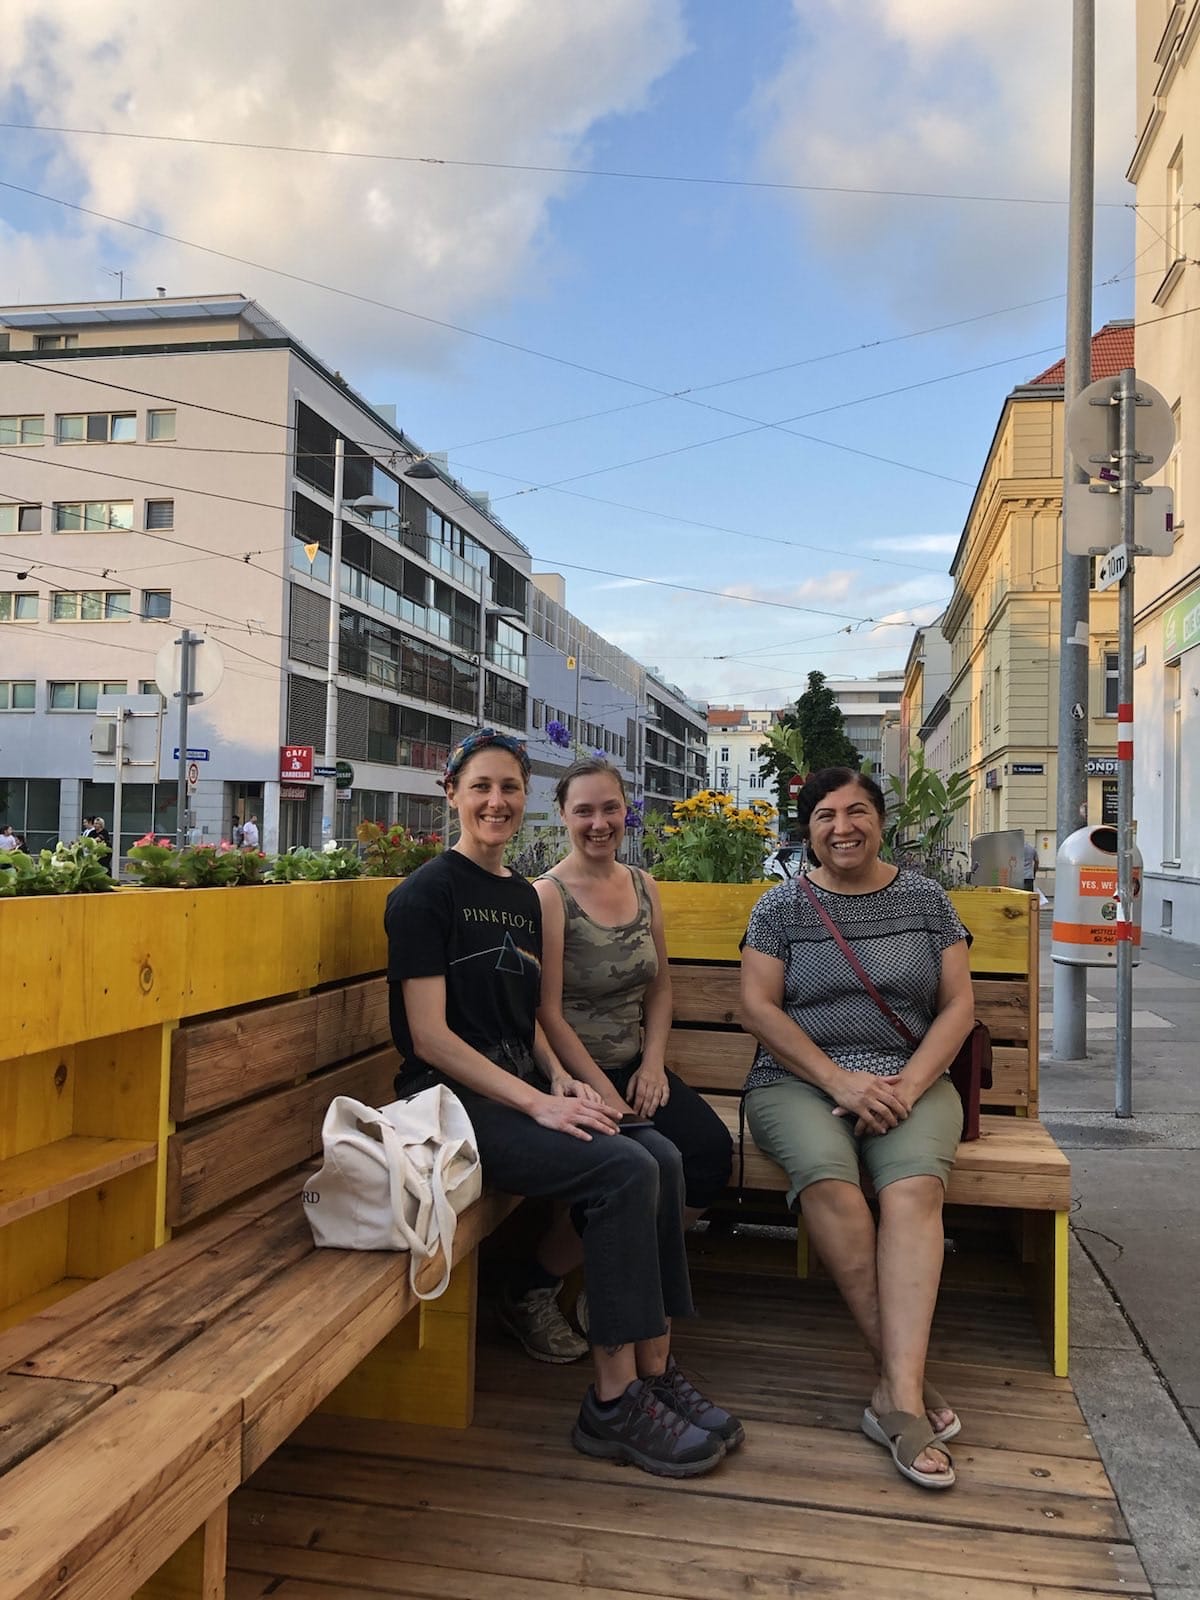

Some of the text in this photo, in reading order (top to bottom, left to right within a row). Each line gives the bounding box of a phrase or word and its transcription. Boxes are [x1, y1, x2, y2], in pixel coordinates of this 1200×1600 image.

[286, 749, 307, 758] CAFE
[1081, 880, 1113, 890] YES, WE
[463, 908, 499, 923] PINK
